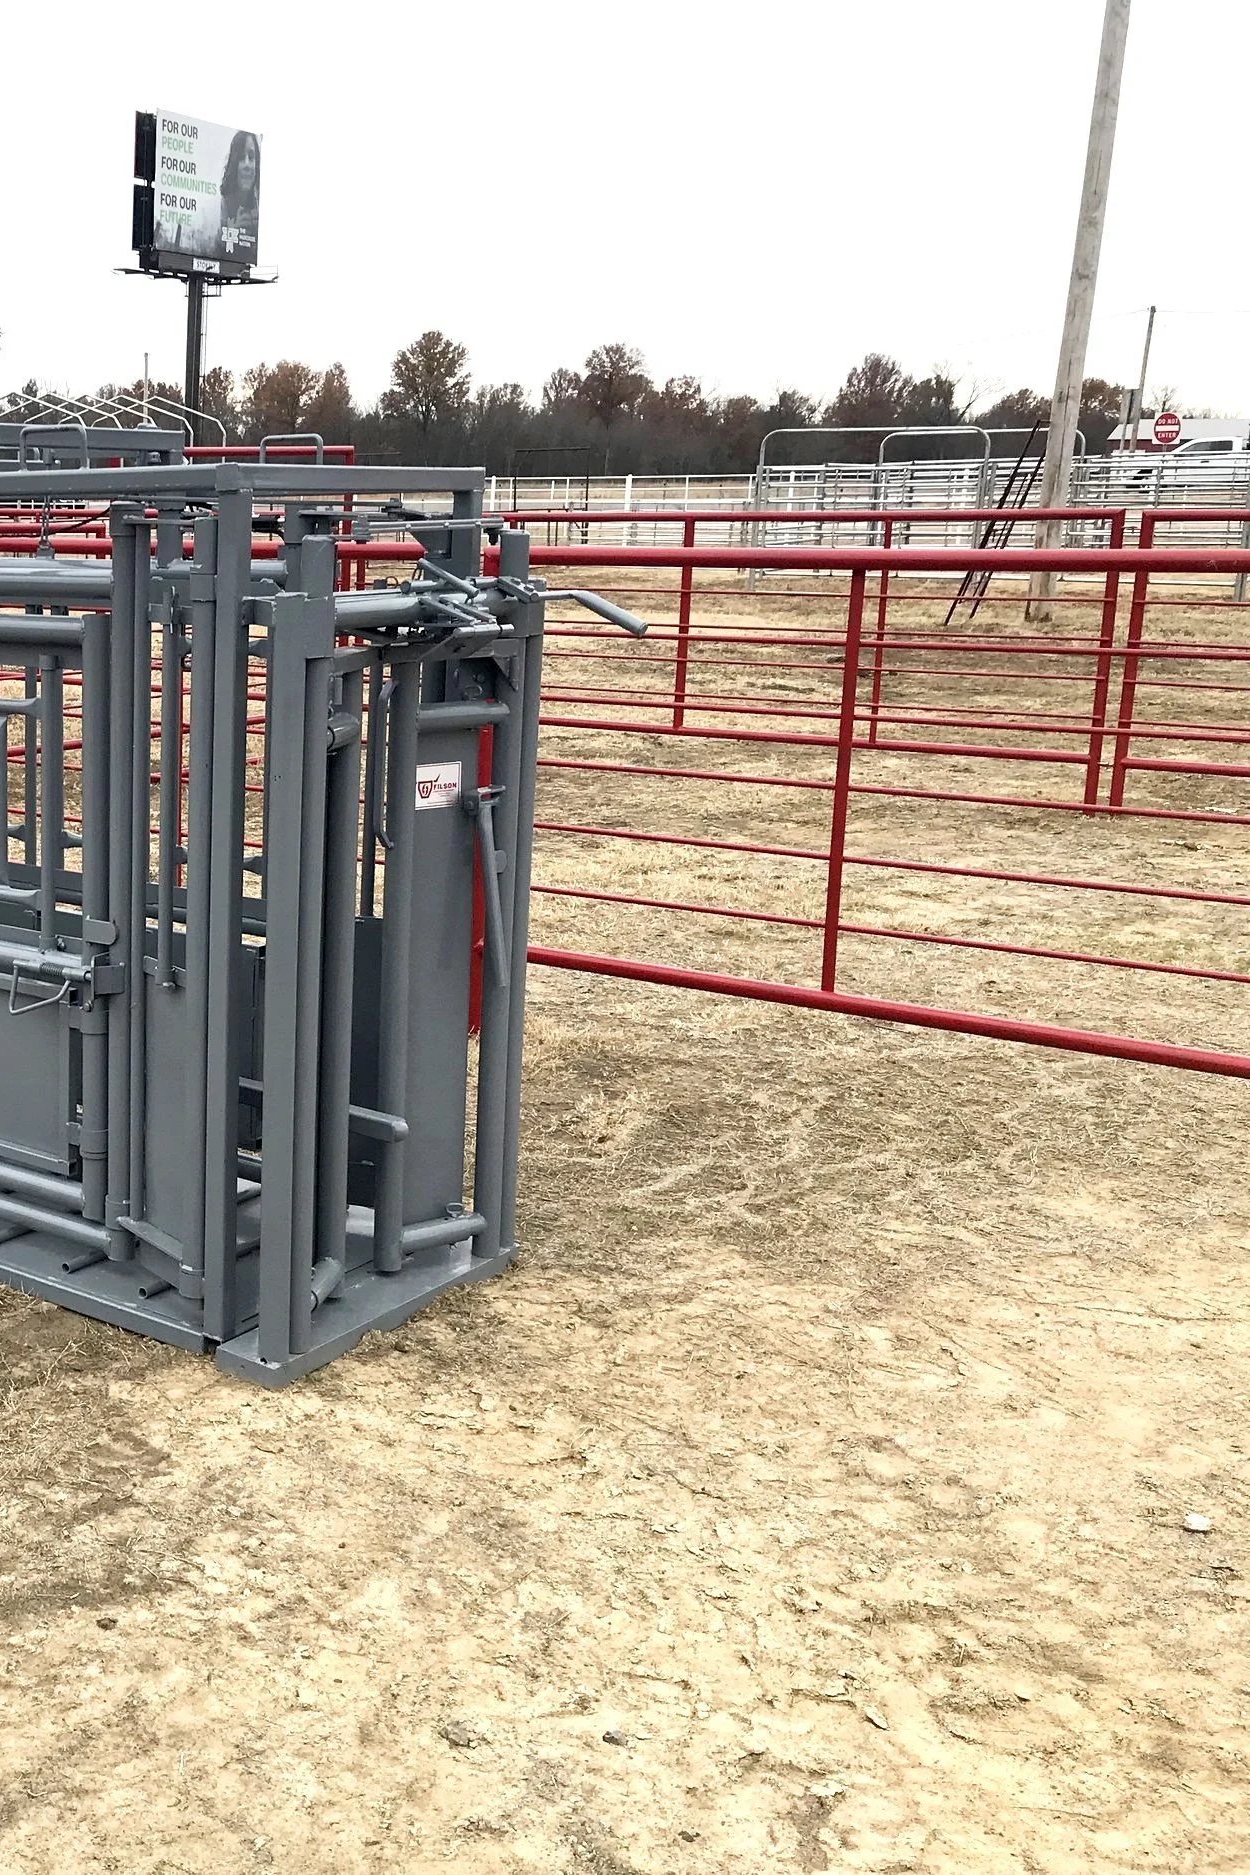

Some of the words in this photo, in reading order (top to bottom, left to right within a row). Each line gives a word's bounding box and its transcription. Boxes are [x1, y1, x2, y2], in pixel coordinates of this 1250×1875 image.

[162, 118, 178, 135] FOR
[181, 123, 198, 139] OUR
[161, 136, 194, 154] PEOPLE
[161, 156, 178, 171] FOR
[180, 159, 197, 175] OUR
[160, 173, 217, 196] COMMUNITIES
[160, 193, 177, 208] FOR
[179, 196, 197, 211] OUR
[159, 209, 193, 226] FUTURE
[433, 782, 457, 790] FILSON
